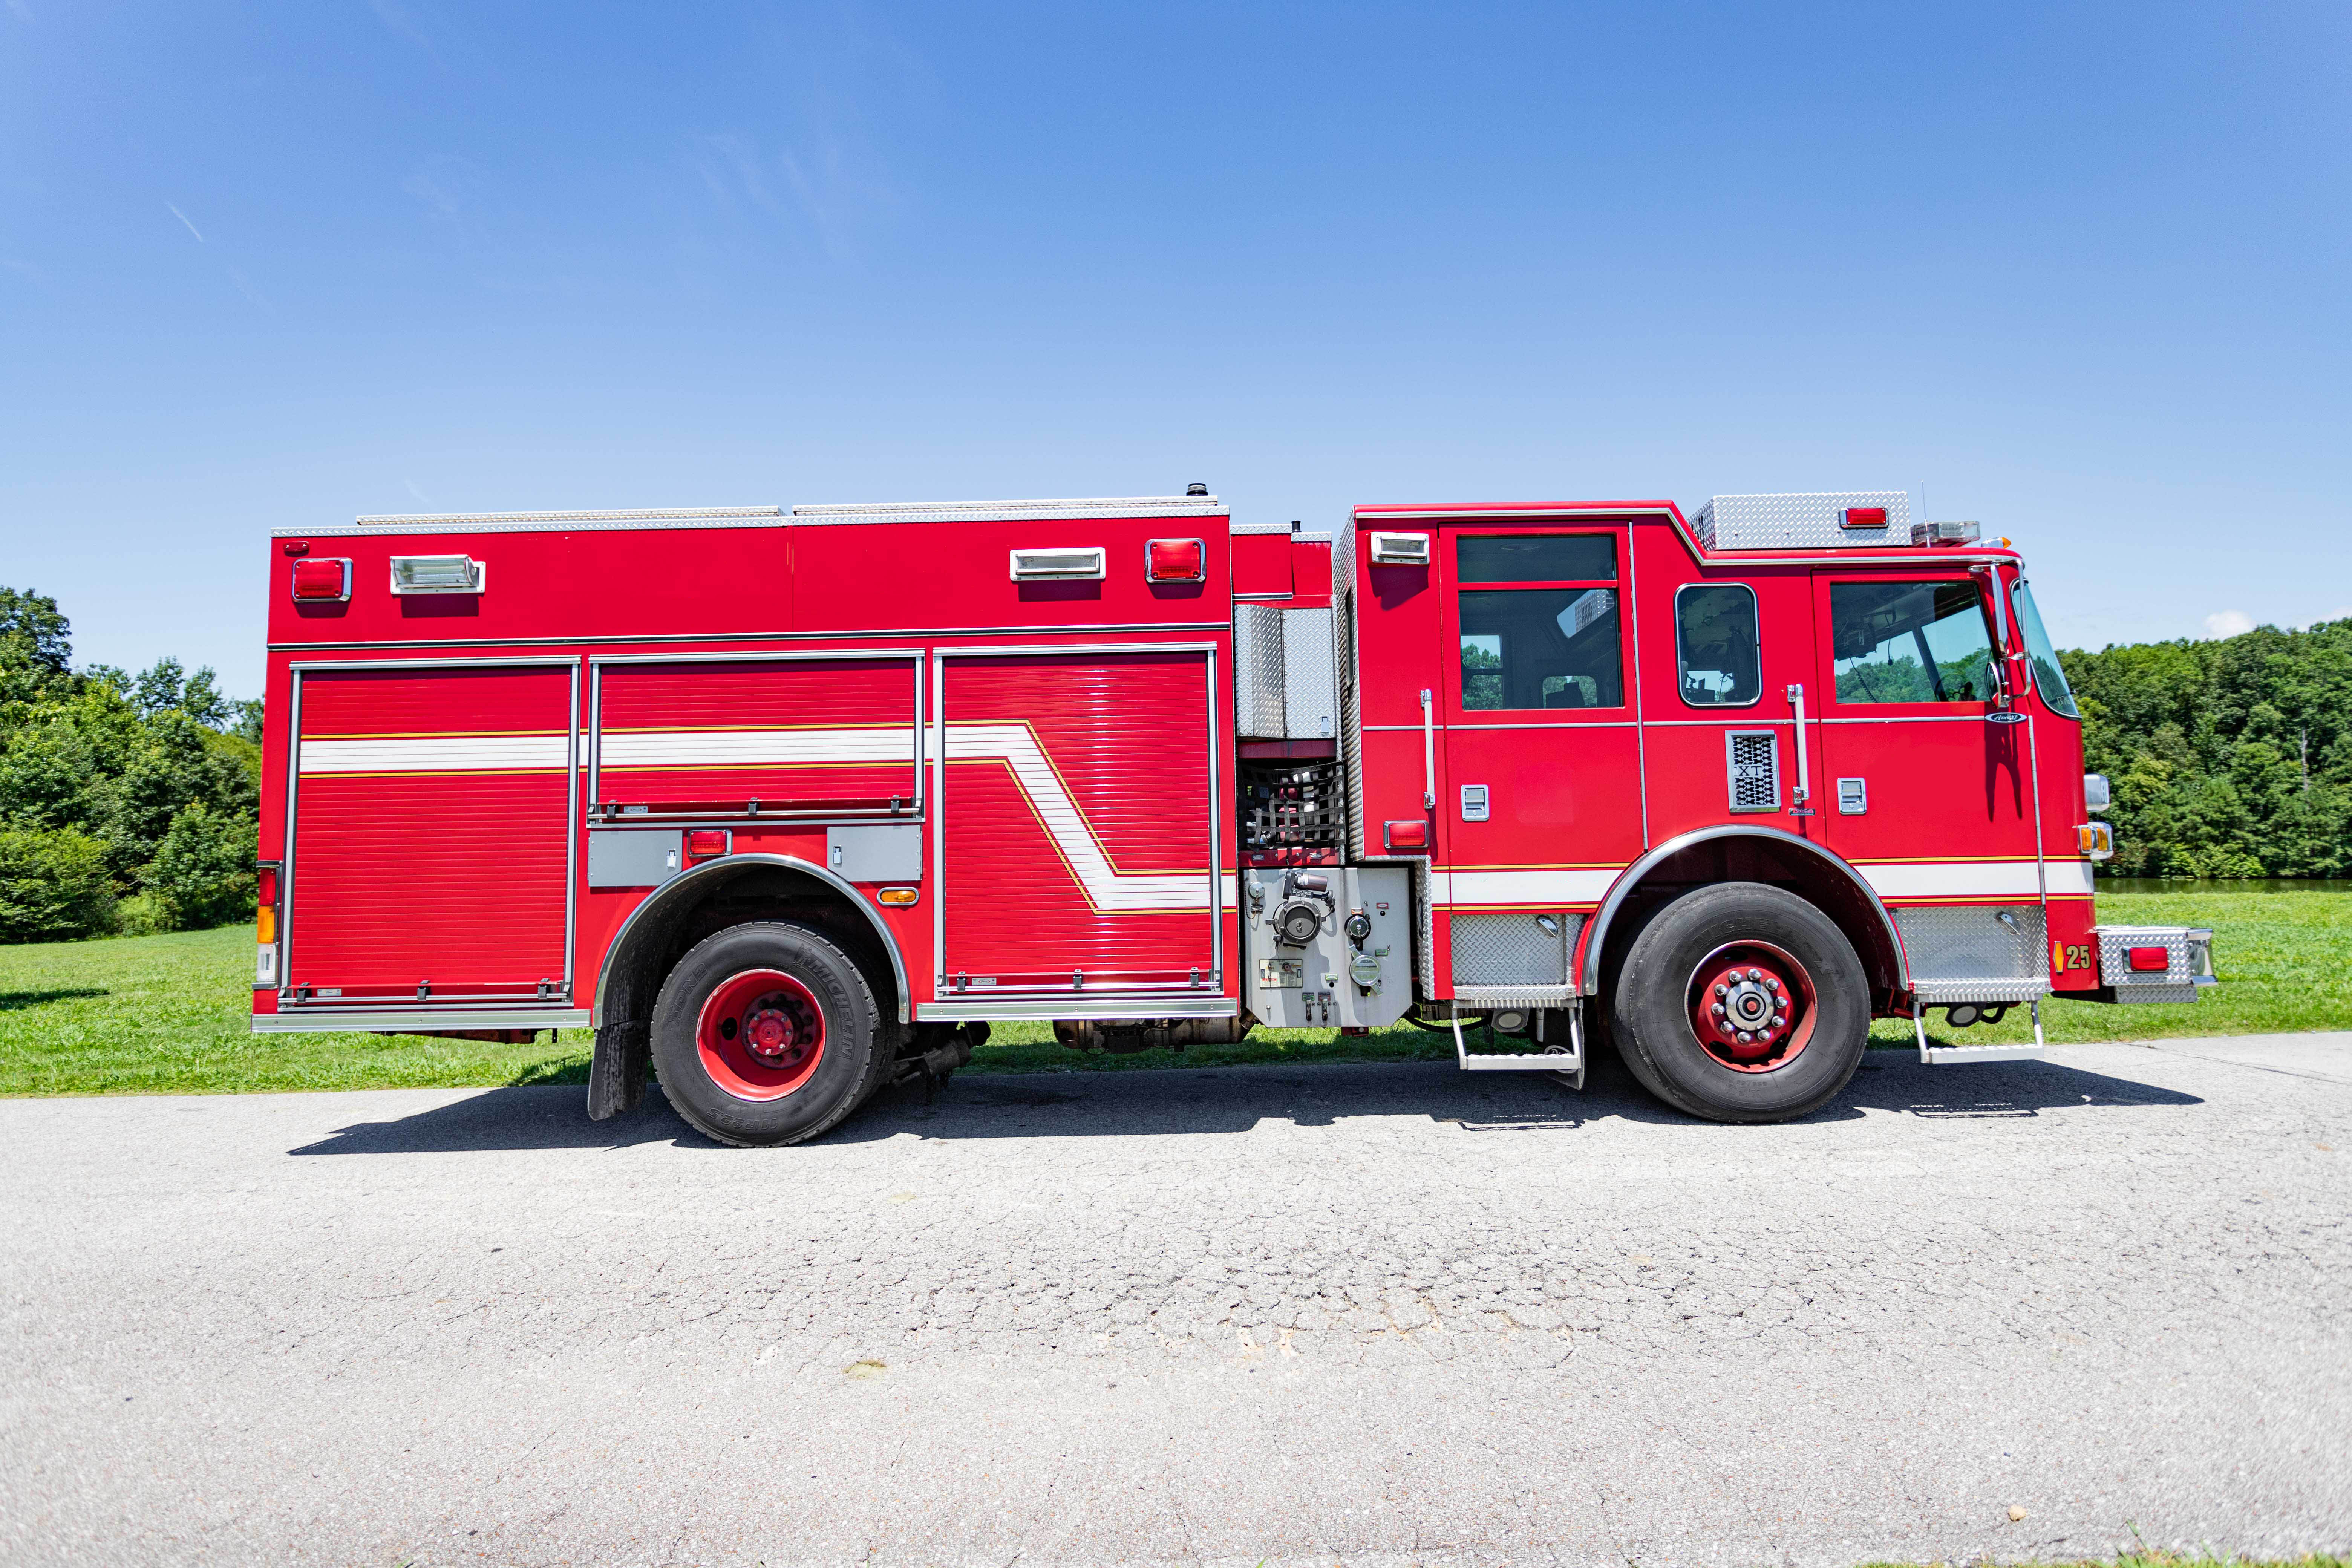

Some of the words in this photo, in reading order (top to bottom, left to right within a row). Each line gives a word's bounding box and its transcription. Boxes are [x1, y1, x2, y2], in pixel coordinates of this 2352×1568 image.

[1738, 766, 1762, 776] XT
[2066, 945, 2091, 970] 25
[668, 963, 708, 1027] XDN2
[810, 960, 854, 1057] MICHELIN
[706, 1107, 778, 1130] 11R22.5
